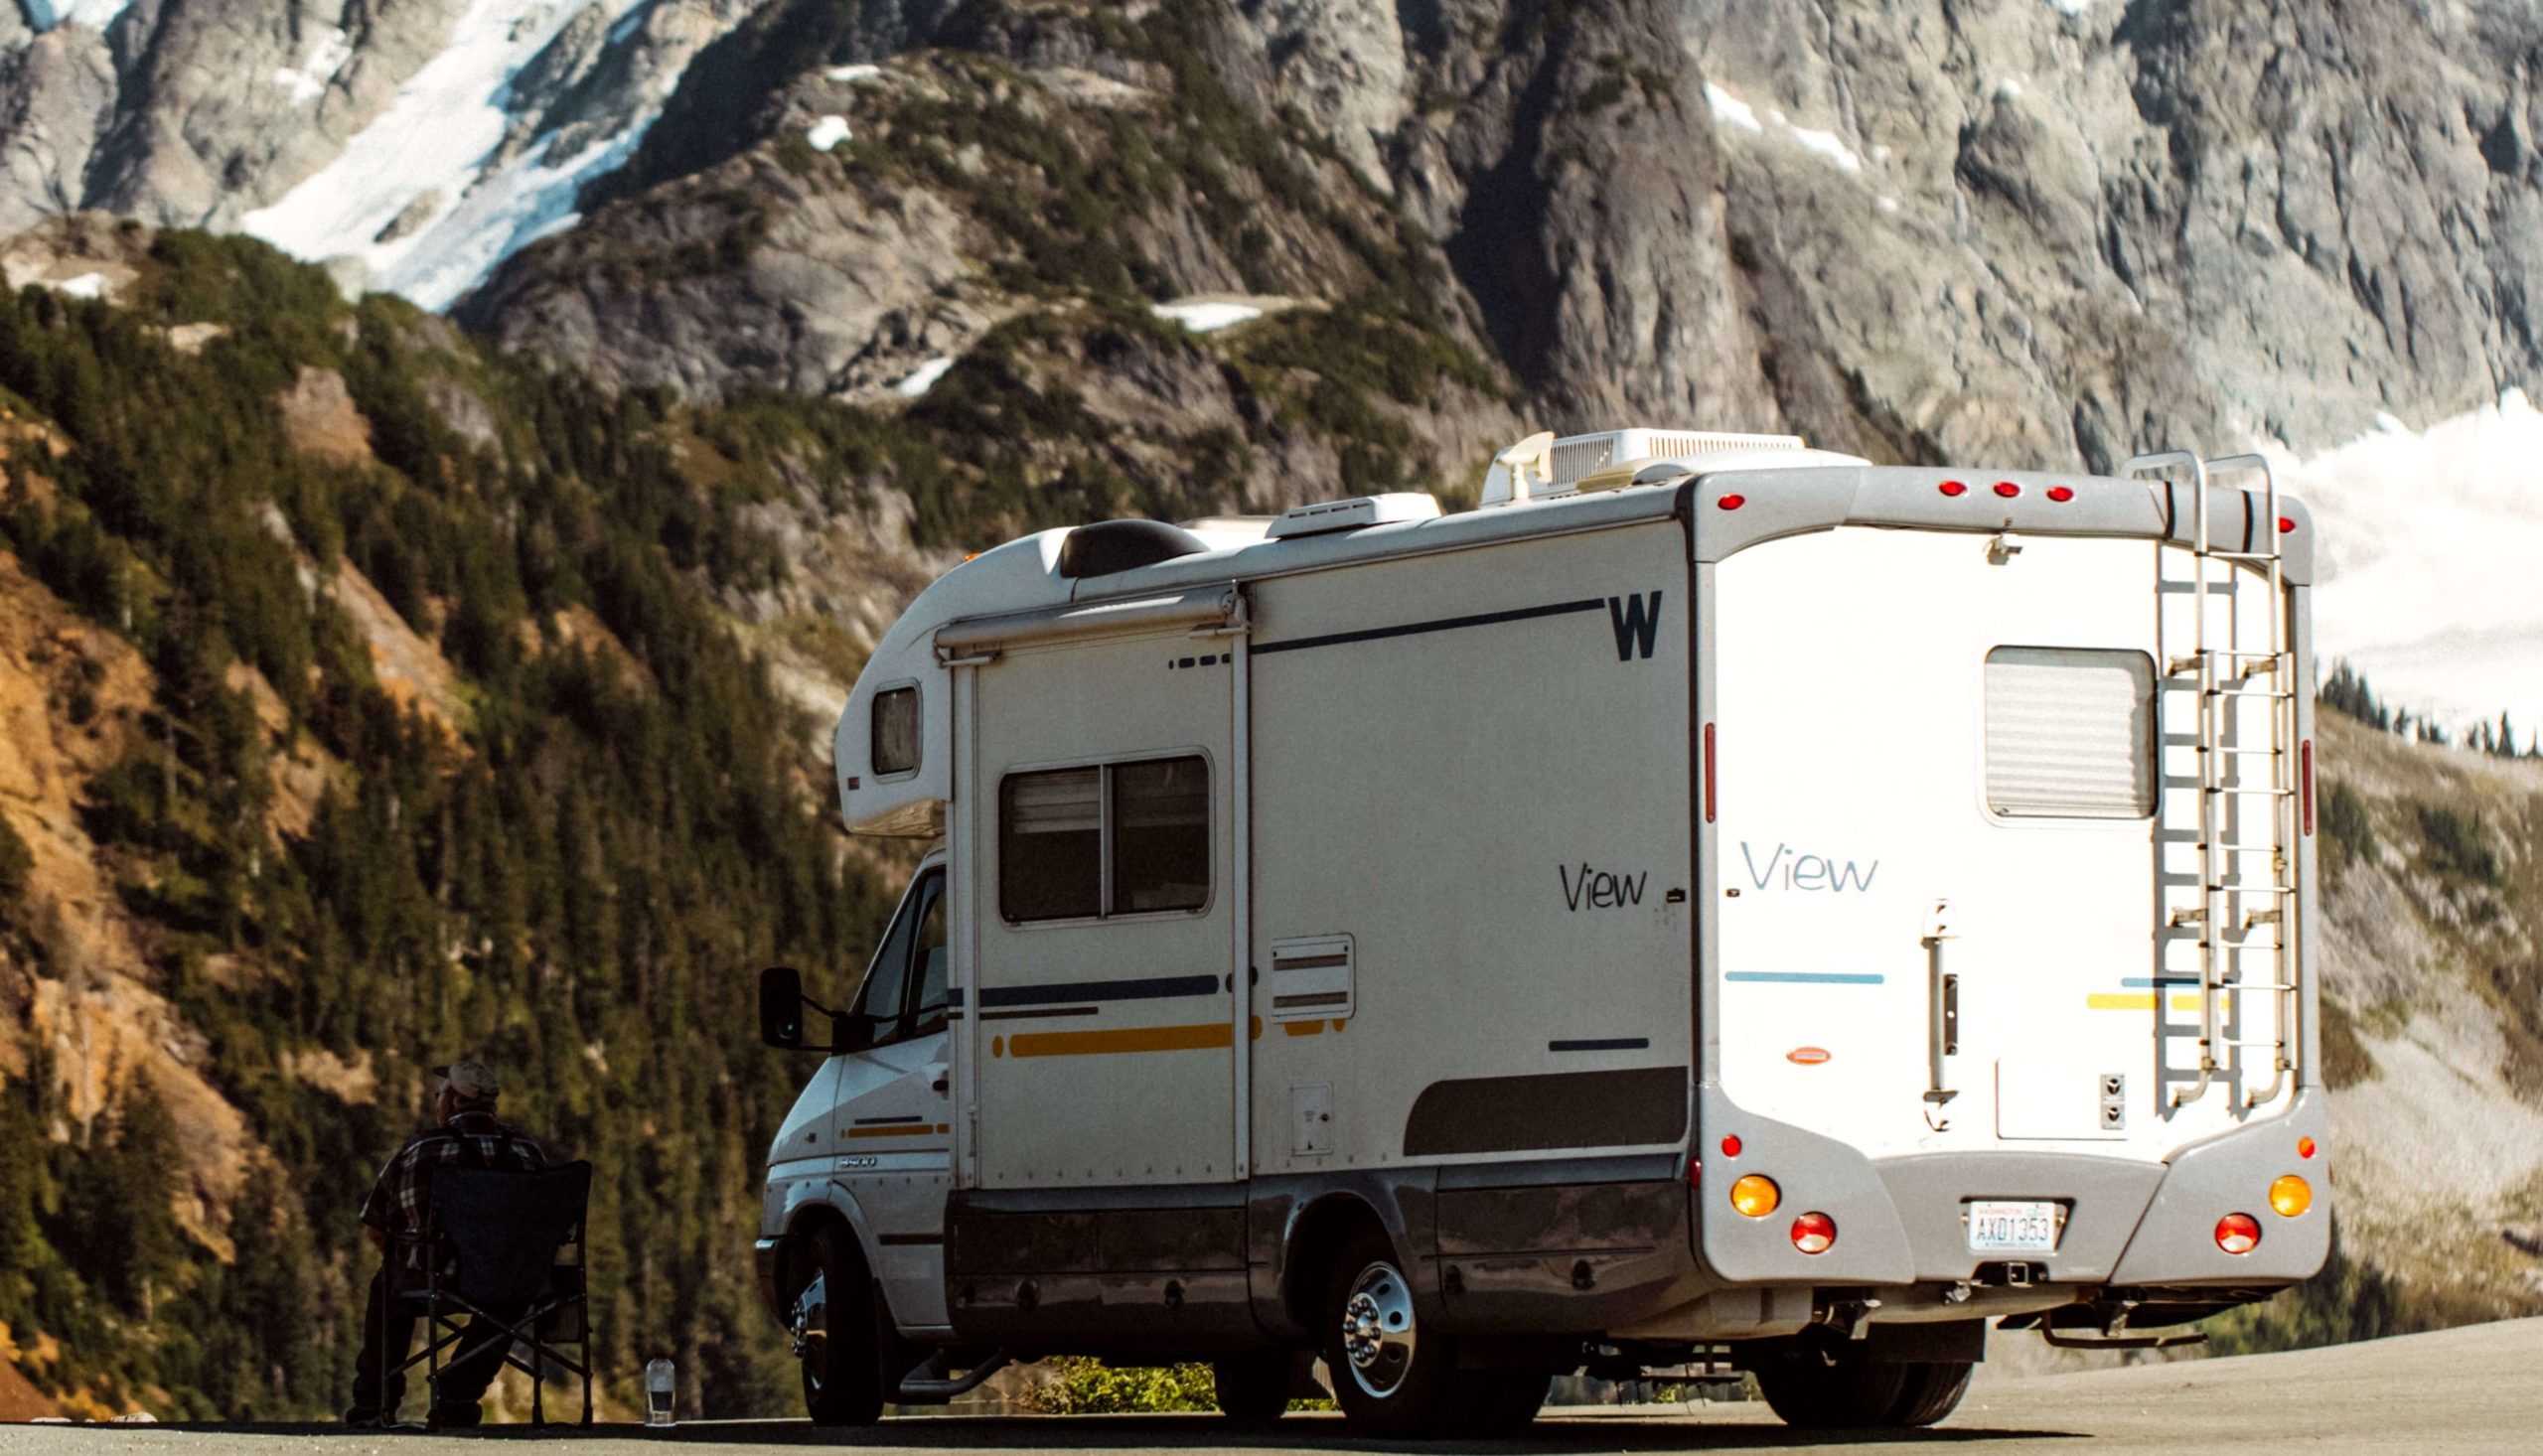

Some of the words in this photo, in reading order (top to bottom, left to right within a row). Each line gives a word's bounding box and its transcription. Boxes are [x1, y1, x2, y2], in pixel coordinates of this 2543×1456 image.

[1607, 590, 1663, 662] W
[1559, 862, 1648, 913] View
[1741, 840, 1879, 893] View
